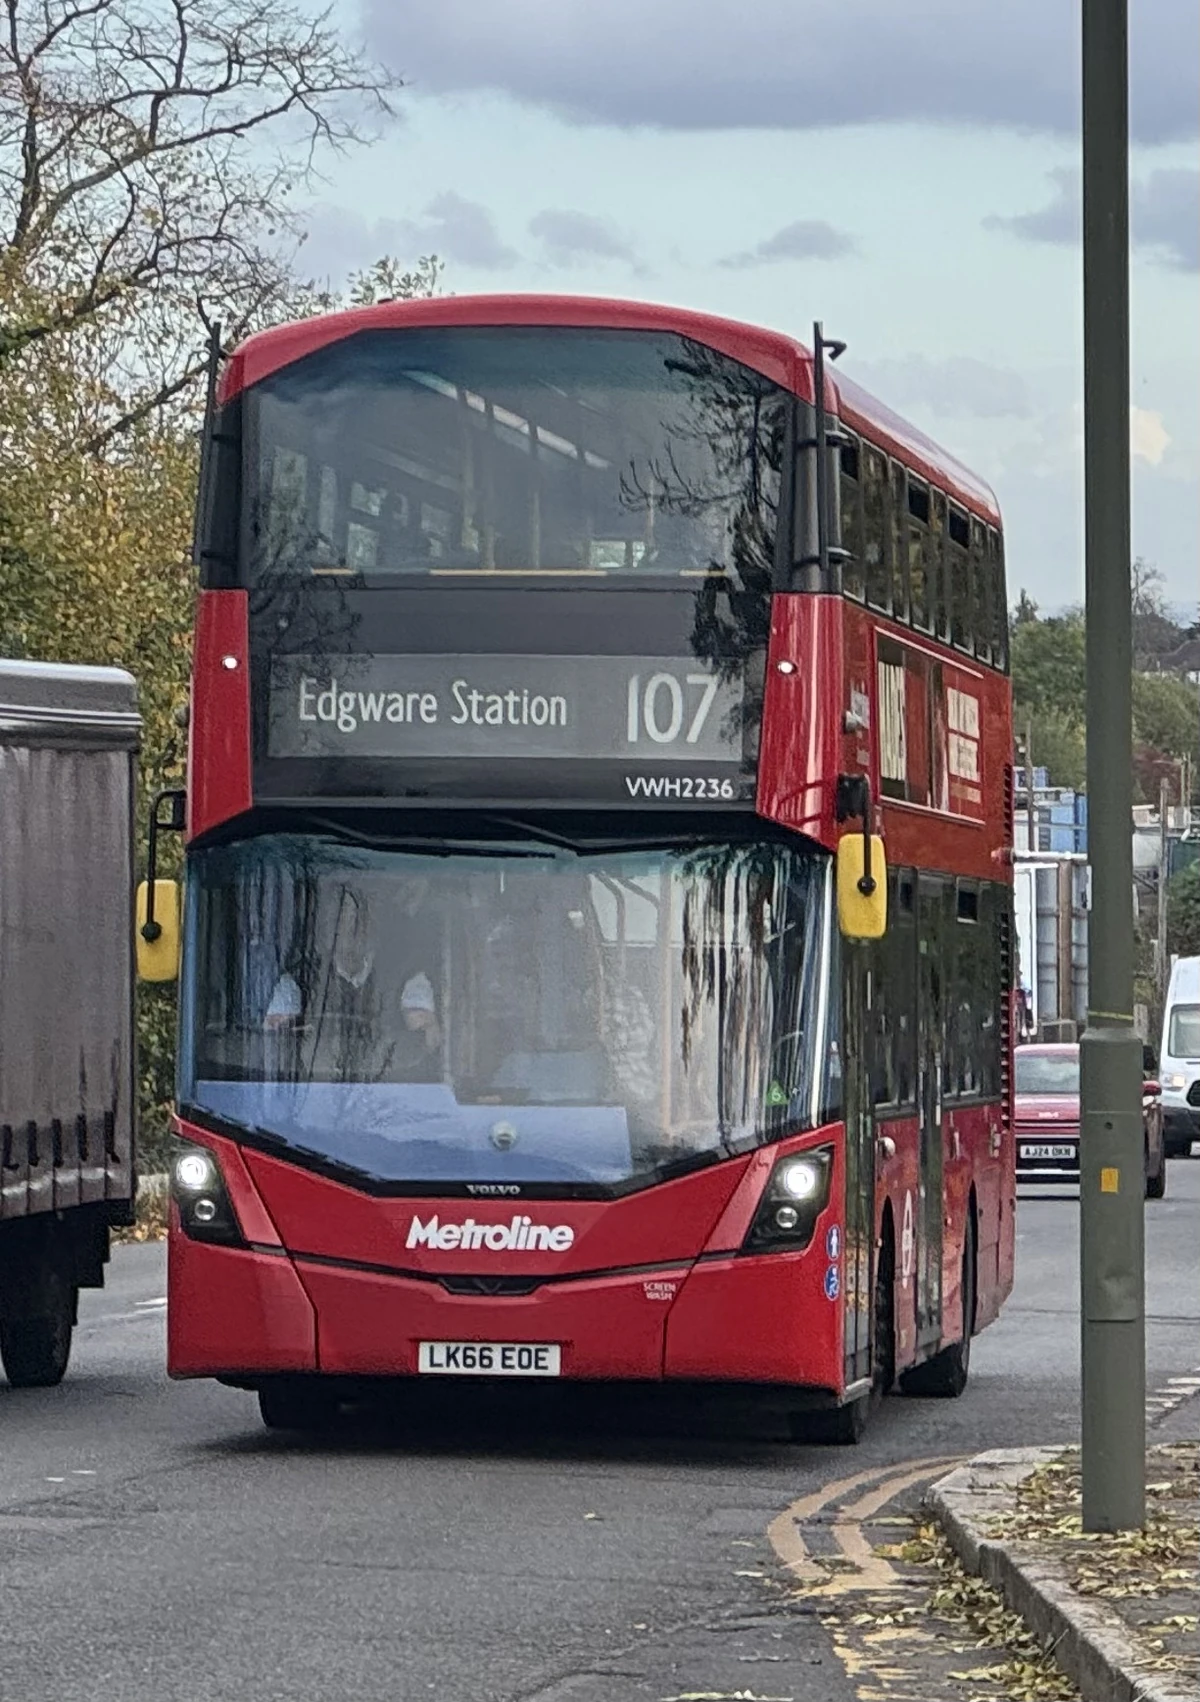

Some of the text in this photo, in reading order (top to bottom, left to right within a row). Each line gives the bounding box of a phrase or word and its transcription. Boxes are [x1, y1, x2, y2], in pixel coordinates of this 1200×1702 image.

[299, 677, 567, 733] Edgware Station
[626, 673, 720, 744] 107
[625, 777, 734, 799] VWH2236
[466, 1184, 521, 1195] VOLVO
[404, 1214, 575, 1252] Metroline
[429, 1346, 550, 1371] LK66 EOE
